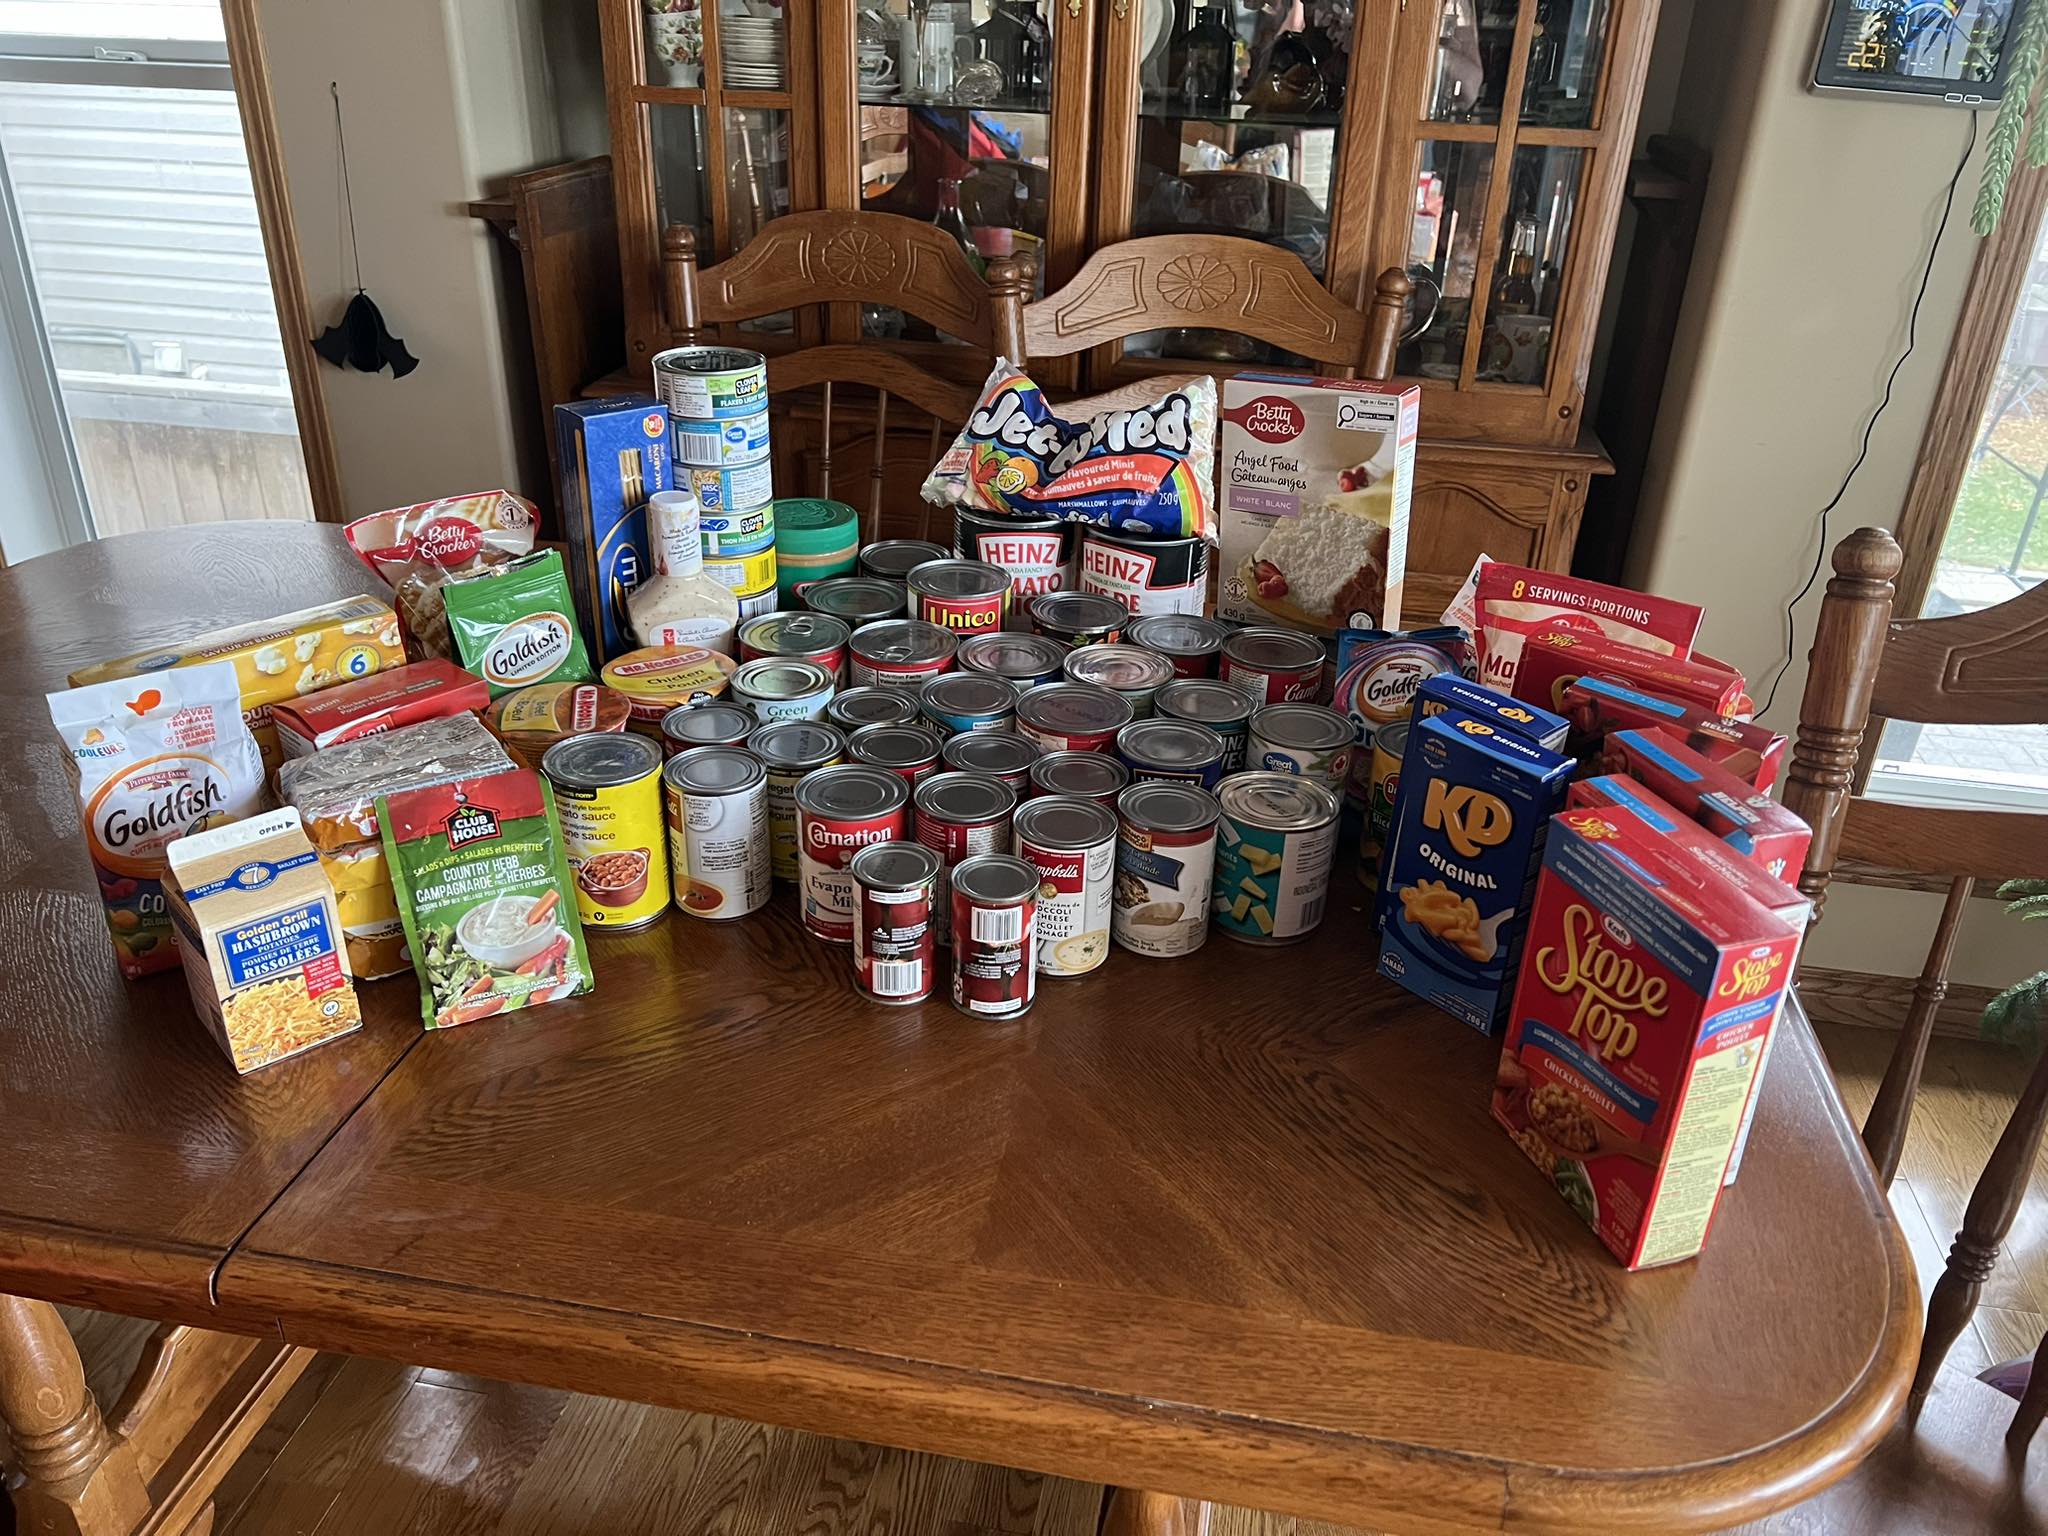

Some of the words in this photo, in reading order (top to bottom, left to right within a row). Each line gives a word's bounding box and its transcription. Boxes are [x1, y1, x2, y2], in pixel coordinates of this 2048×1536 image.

[720, 399, 743, 407] FLAKED
[1252, 402, 1292, 423] Betty
[1246, 414, 1299, 436] Crocker
[653, 443, 662, 489] MACARONI
[1068, 463, 1110, 479] Flavoured
[1111, 460, 1135, 471] Minis
[1234, 450, 1267, 471] Angel
[1269, 456, 1299, 473] Food
[1093, 473, 1120, 485] saveur
[1122, 470, 1133, 480] de
[1134, 469, 1159, 484] fruits
[1231, 468, 1270, 484] Gâteau
[1278, 478, 1307, 492] anges
[702, 484, 718, 492] MSC
[1058, 499, 1108, 508] MARSHMALLOWS
[1112, 498, 1147, 507] GUIMAUVES
[1158, 492, 1173, 506] 250
[1235, 495, 1260, 506] WHITE
[1265, 499, 1292, 510] BLANC
[742, 514, 763, 527] CLOVER
[742, 524, 756, 533] LEAF
[429, 525, 466, 545] Betty
[421, 537, 476, 559] Crocker
[985, 543, 1056, 564] HEINZ
[1085, 549, 1145, 584] HEINZ
[1011, 573, 1063, 597] MATO
[1223, 607, 1238, 618] 430
[1512, 580, 1526, 599] 8
[1528, 585, 1586, 607] SERVINGS
[1592, 598, 1650, 625] PORTIONS
[929, 606, 996, 628] Unico
[492, 623, 561, 675] Goldfish
[350, 653, 366, 675] 6
[510, 658, 536, 677] LIMITED
[536, 643, 561, 663] EDITION
[1484, 652, 1516, 679] Ma
[646, 669, 706, 685] Chicken
[666, 676, 715, 690] Poulet
[1367, 672, 1433, 701] Goldfi
[766, 704, 808, 717] Green
[1452, 686, 1498, 708] ORIGINAL
[1497, 707, 1535, 723] KD
[168, 714, 213, 729] FROMAGE
[1701, 720, 1744, 739] HELPER
[181, 729, 216, 742] VITAMINES
[1456, 720, 1494, 737] KD
[1492, 734, 1541, 760] ORIGINAL
[73, 742, 126, 759] COULEURS
[1265, 754, 1293, 770] Great
[129, 773, 166, 788] PEPPERIDGE
[104, 776, 222, 847] Goldfish
[581, 811, 617, 821] sauce
[589, 804, 611, 812] beans
[1422, 777, 1513, 857] KD
[1712, 791, 1760, 823] HELPER
[259, 823, 284, 836] OPEN
[455, 815, 488, 829] CLUB
[453, 823, 496, 843] HOUSE
[581, 832, 616, 841] sauce
[807, 820, 893, 849] Carnation
[444, 855, 460, 867] DIPS
[464, 847, 494, 860] SALADES
[503, 843, 544, 853] TREMPETTES
[245, 866, 259, 884] 7
[443, 860, 490, 883] COUNTRY
[1419, 843, 1498, 889] ORIGINAL
[195, 885, 210, 895] EASY
[415, 875, 495, 904] CAMPAGNARDE
[507, 863, 546, 883] HERBES
[811, 874, 853, 899] Evapo
[1037, 905, 1072, 915] OCCOLI
[231, 914, 321, 954] HASHBROWN
[237, 922, 280, 941] Golden
[282, 909, 308, 924] Grill
[1036, 928, 1069, 938] OMAGE
[1608, 919, 1630, 943] Kraft
[242, 951, 278, 968] POMMES
[294, 936, 320, 951] TERRE
[258, 934, 300, 953] POTATOES
[243, 943, 321, 980] RISSOLÉES
[1381, 955, 1405, 975] CANADA
[1536, 904, 1670, 1017] Stove
[1718, 952, 1783, 996] Stove
[1736, 974, 1771, 1001] Top
[1466, 1012, 1480, 1026] 200
[1568, 975, 1638, 1062] Top
[1543, 1057, 1617, 1115] CHICKEN-POULET
